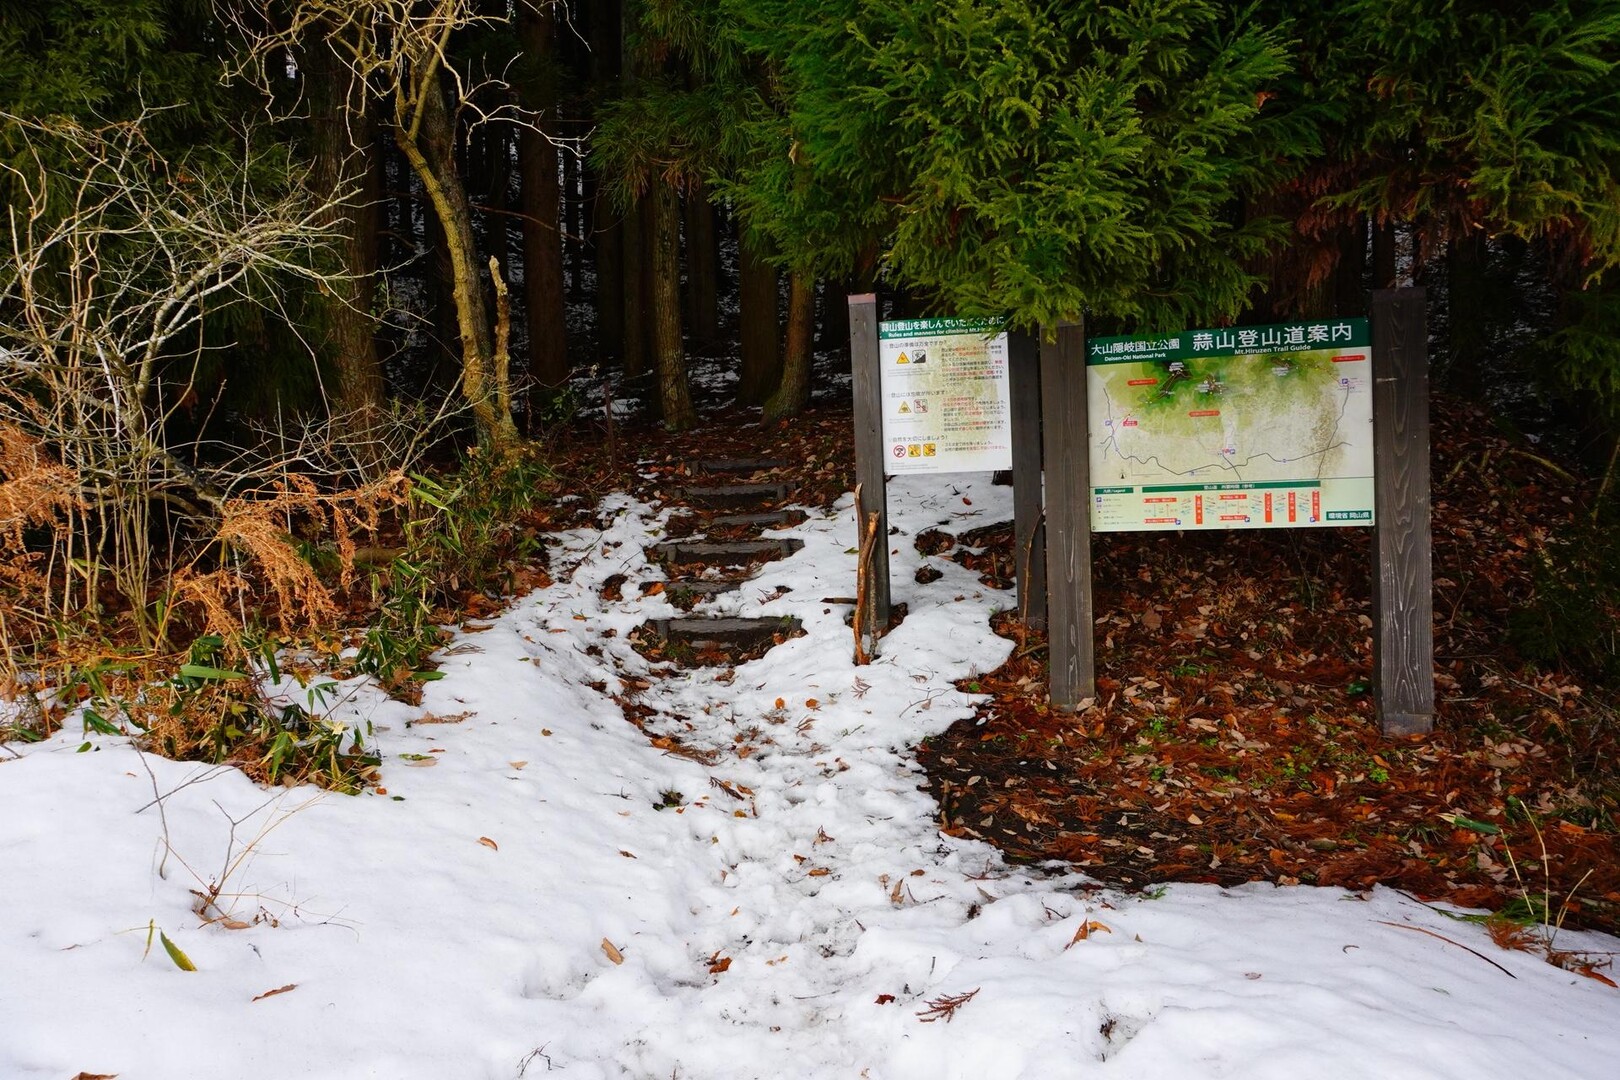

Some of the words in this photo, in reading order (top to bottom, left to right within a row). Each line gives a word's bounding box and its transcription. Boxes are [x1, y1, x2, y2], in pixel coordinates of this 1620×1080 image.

[1193, 323, 1352, 351] 蒜山登山道案内
[1091, 338, 1180, 355] 大山隠岐国立公園
[1235, 347, 1272, 355] Mt.Hiruzen
